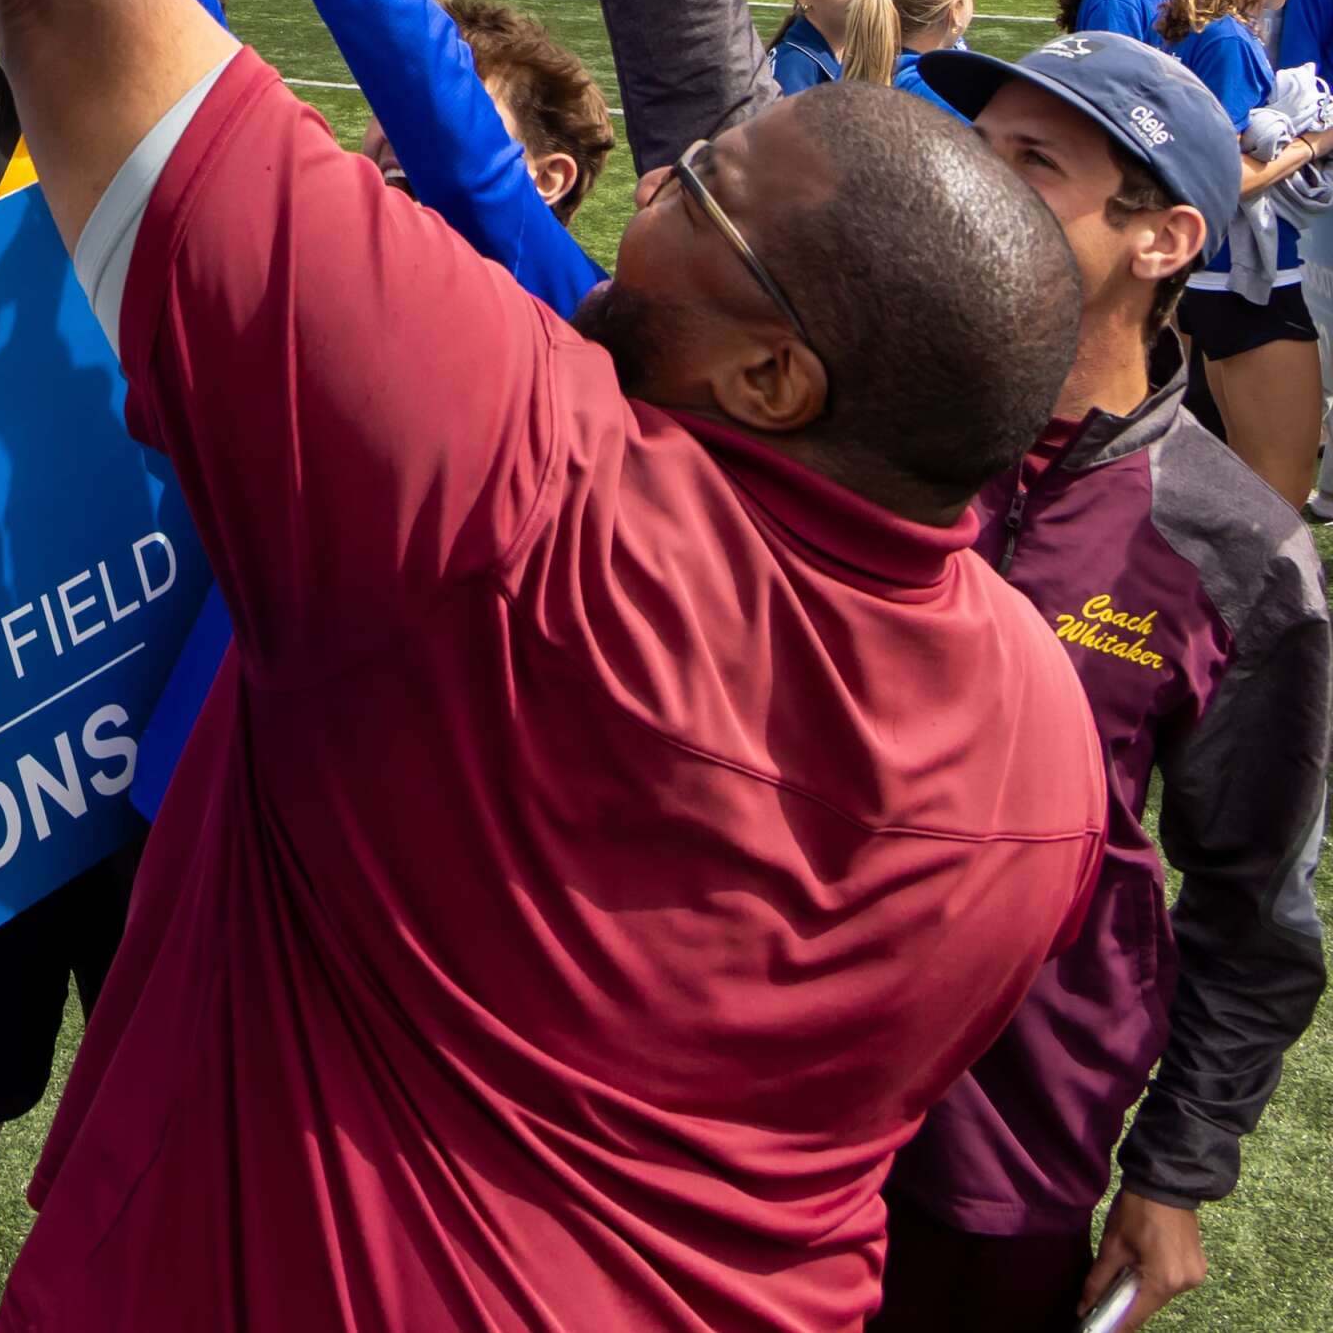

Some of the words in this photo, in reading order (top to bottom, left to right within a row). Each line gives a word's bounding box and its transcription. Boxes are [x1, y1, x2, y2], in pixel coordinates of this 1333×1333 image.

[0, 531, 177, 679] FIELD
[1082, 593, 1158, 635] Coach
[1056, 614, 1163, 669] Whitaker
